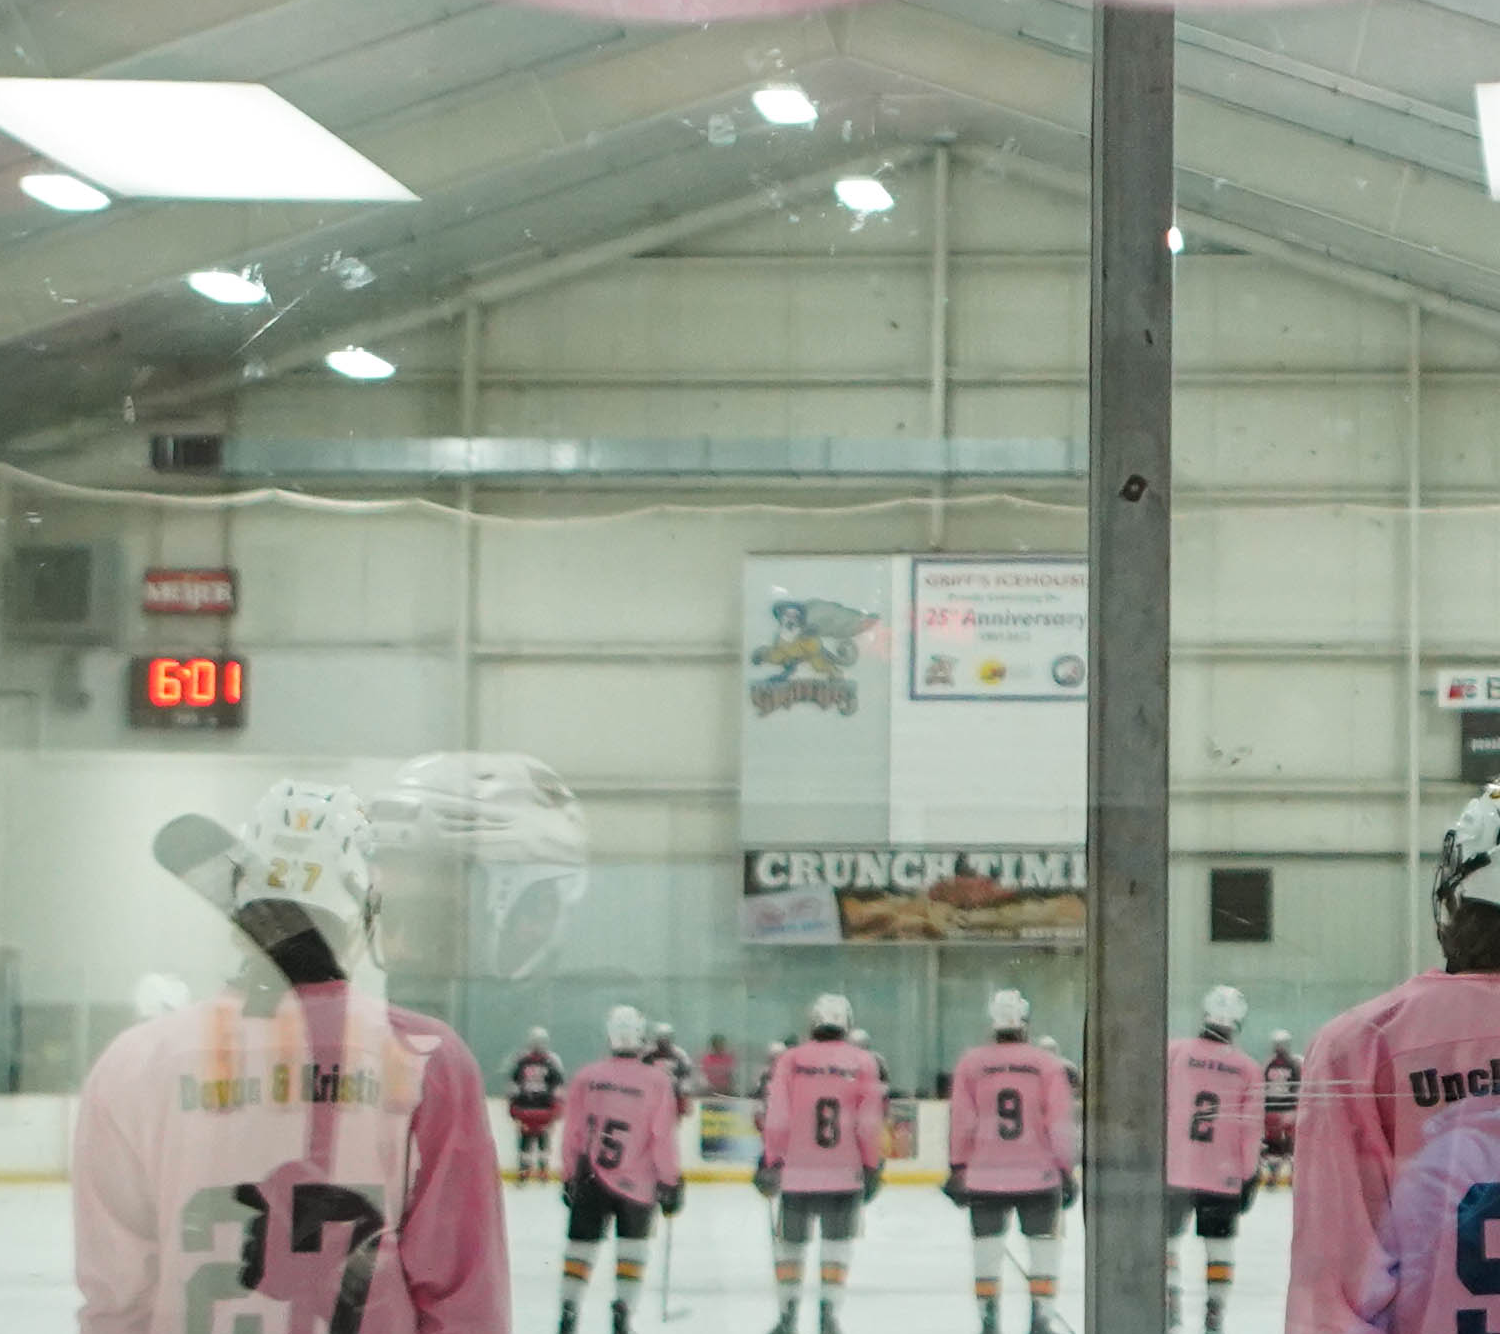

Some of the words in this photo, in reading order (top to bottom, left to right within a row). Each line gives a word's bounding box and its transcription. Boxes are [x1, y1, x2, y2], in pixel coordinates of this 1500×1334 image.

[961, 607, 1086, 630] Anniversary
[149, 657, 243, 708] 6:01
[756, 851, 955, 887] CRUNCH
[815, 1097, 841, 1149] 8
[997, 1087, 1024, 1141] 9
[1189, 1090, 1220, 1143] 2
